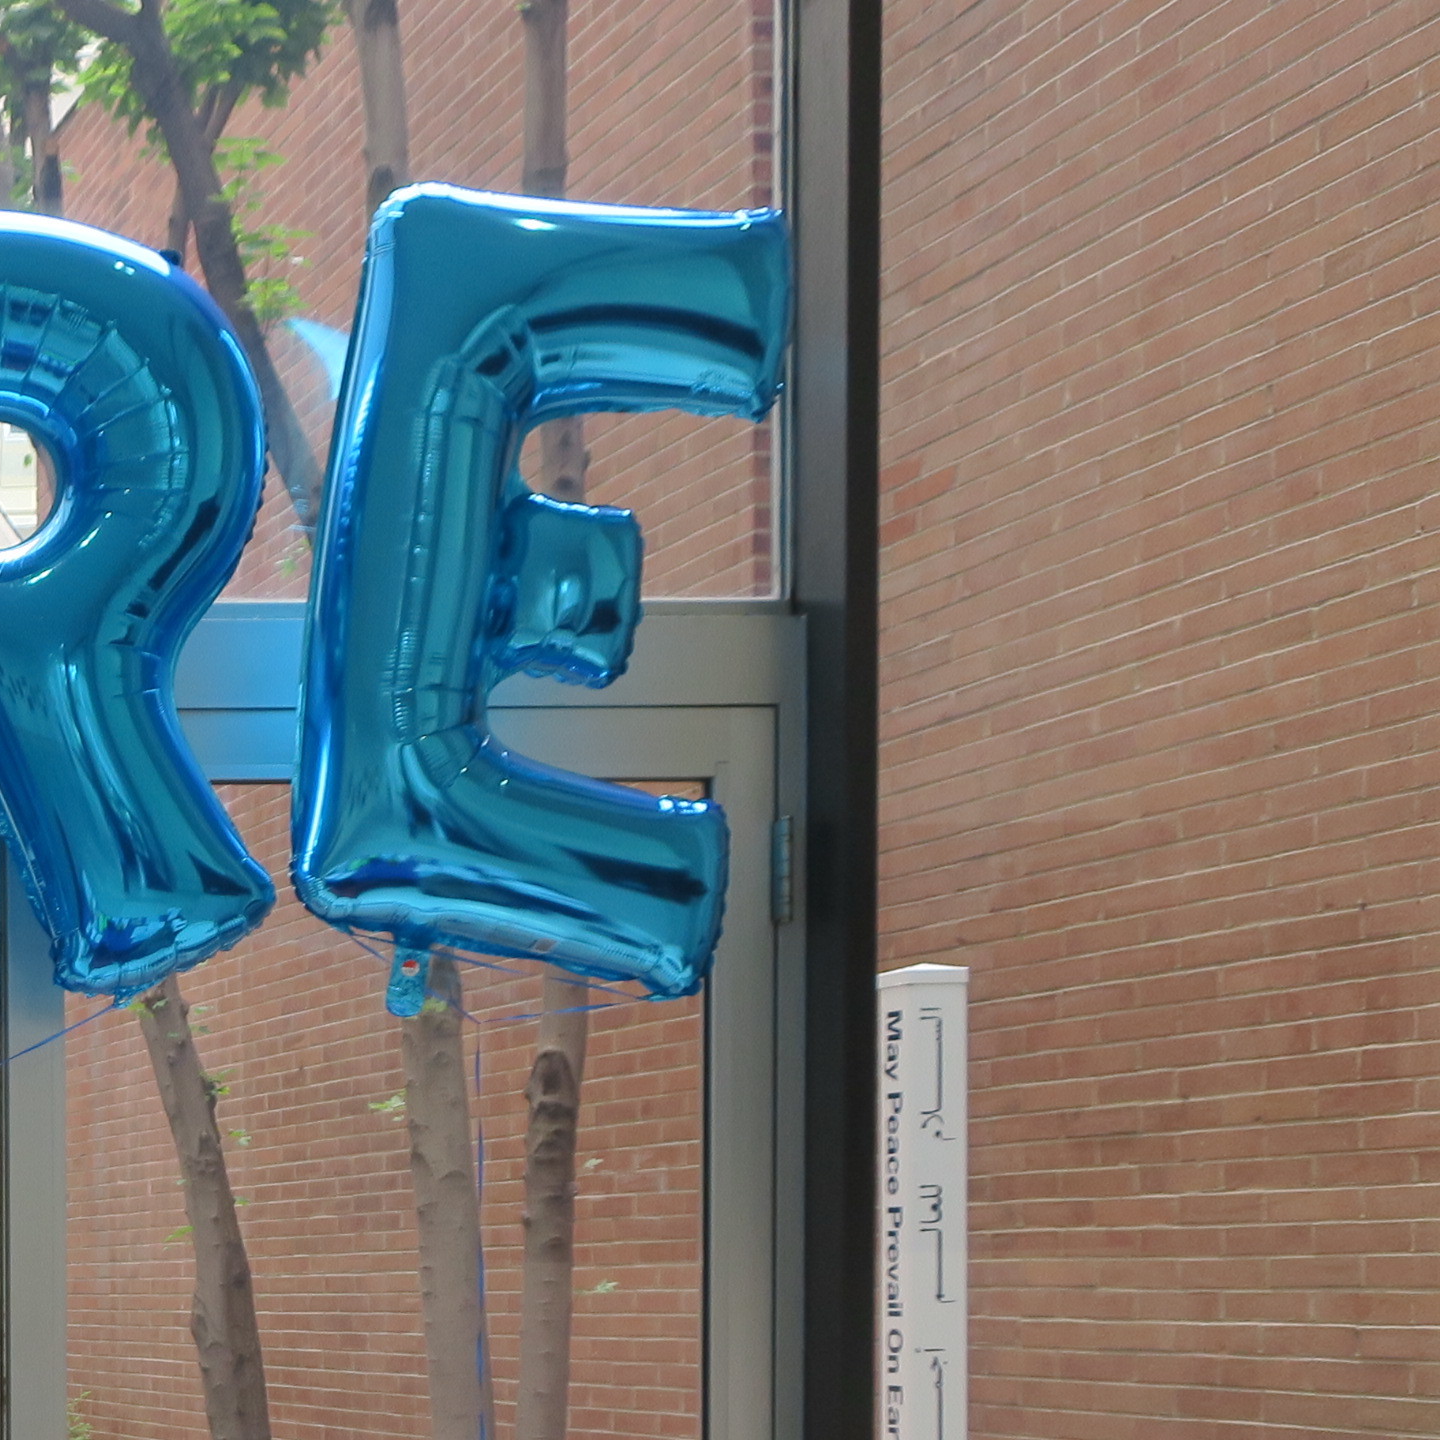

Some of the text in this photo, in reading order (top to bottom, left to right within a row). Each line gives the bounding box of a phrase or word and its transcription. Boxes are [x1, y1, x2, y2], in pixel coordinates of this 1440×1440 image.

[884, 1009, 904, 1081] May
[886, 1091, 904, 1195] Peace
[886, 1205, 904, 1317] Prevail
[886, 1328, 904, 1374] On
